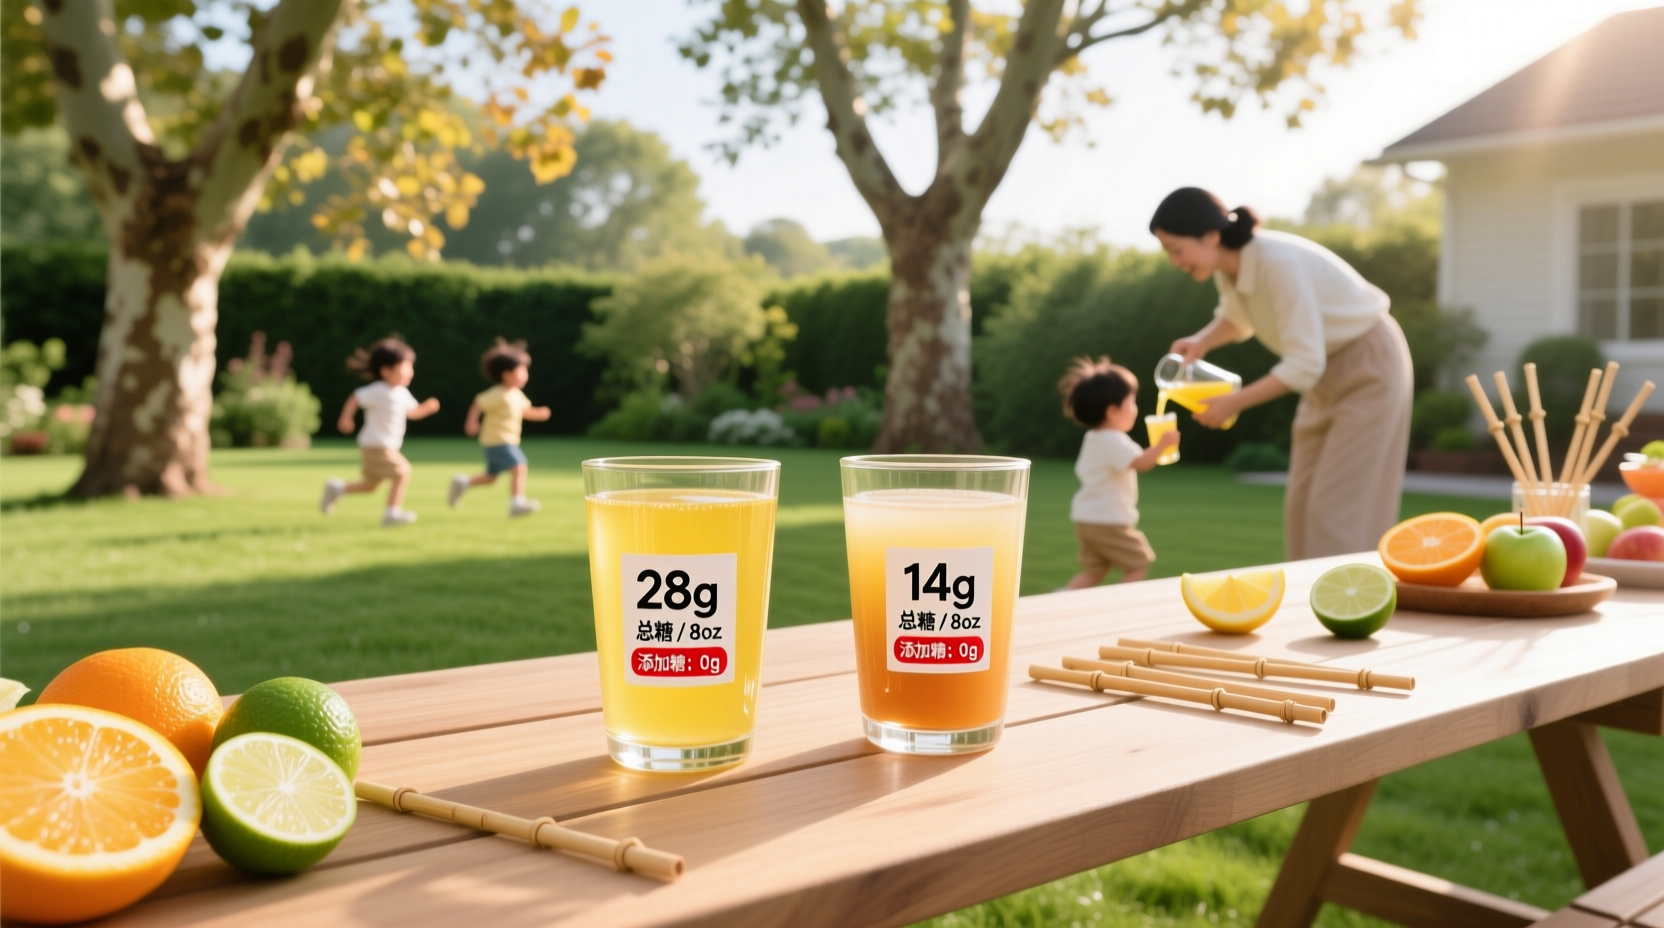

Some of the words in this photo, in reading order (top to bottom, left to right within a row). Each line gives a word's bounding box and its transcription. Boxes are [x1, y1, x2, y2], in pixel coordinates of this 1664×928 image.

[637, 569, 718, 618] 28g
[904, 563, 975, 609] 14g
[636, 620, 673, 642] 总糖
[689, 623, 722, 641] 8oz
[899, 610, 936, 631] 总糖
[950, 614, 981, 629] 8oz
